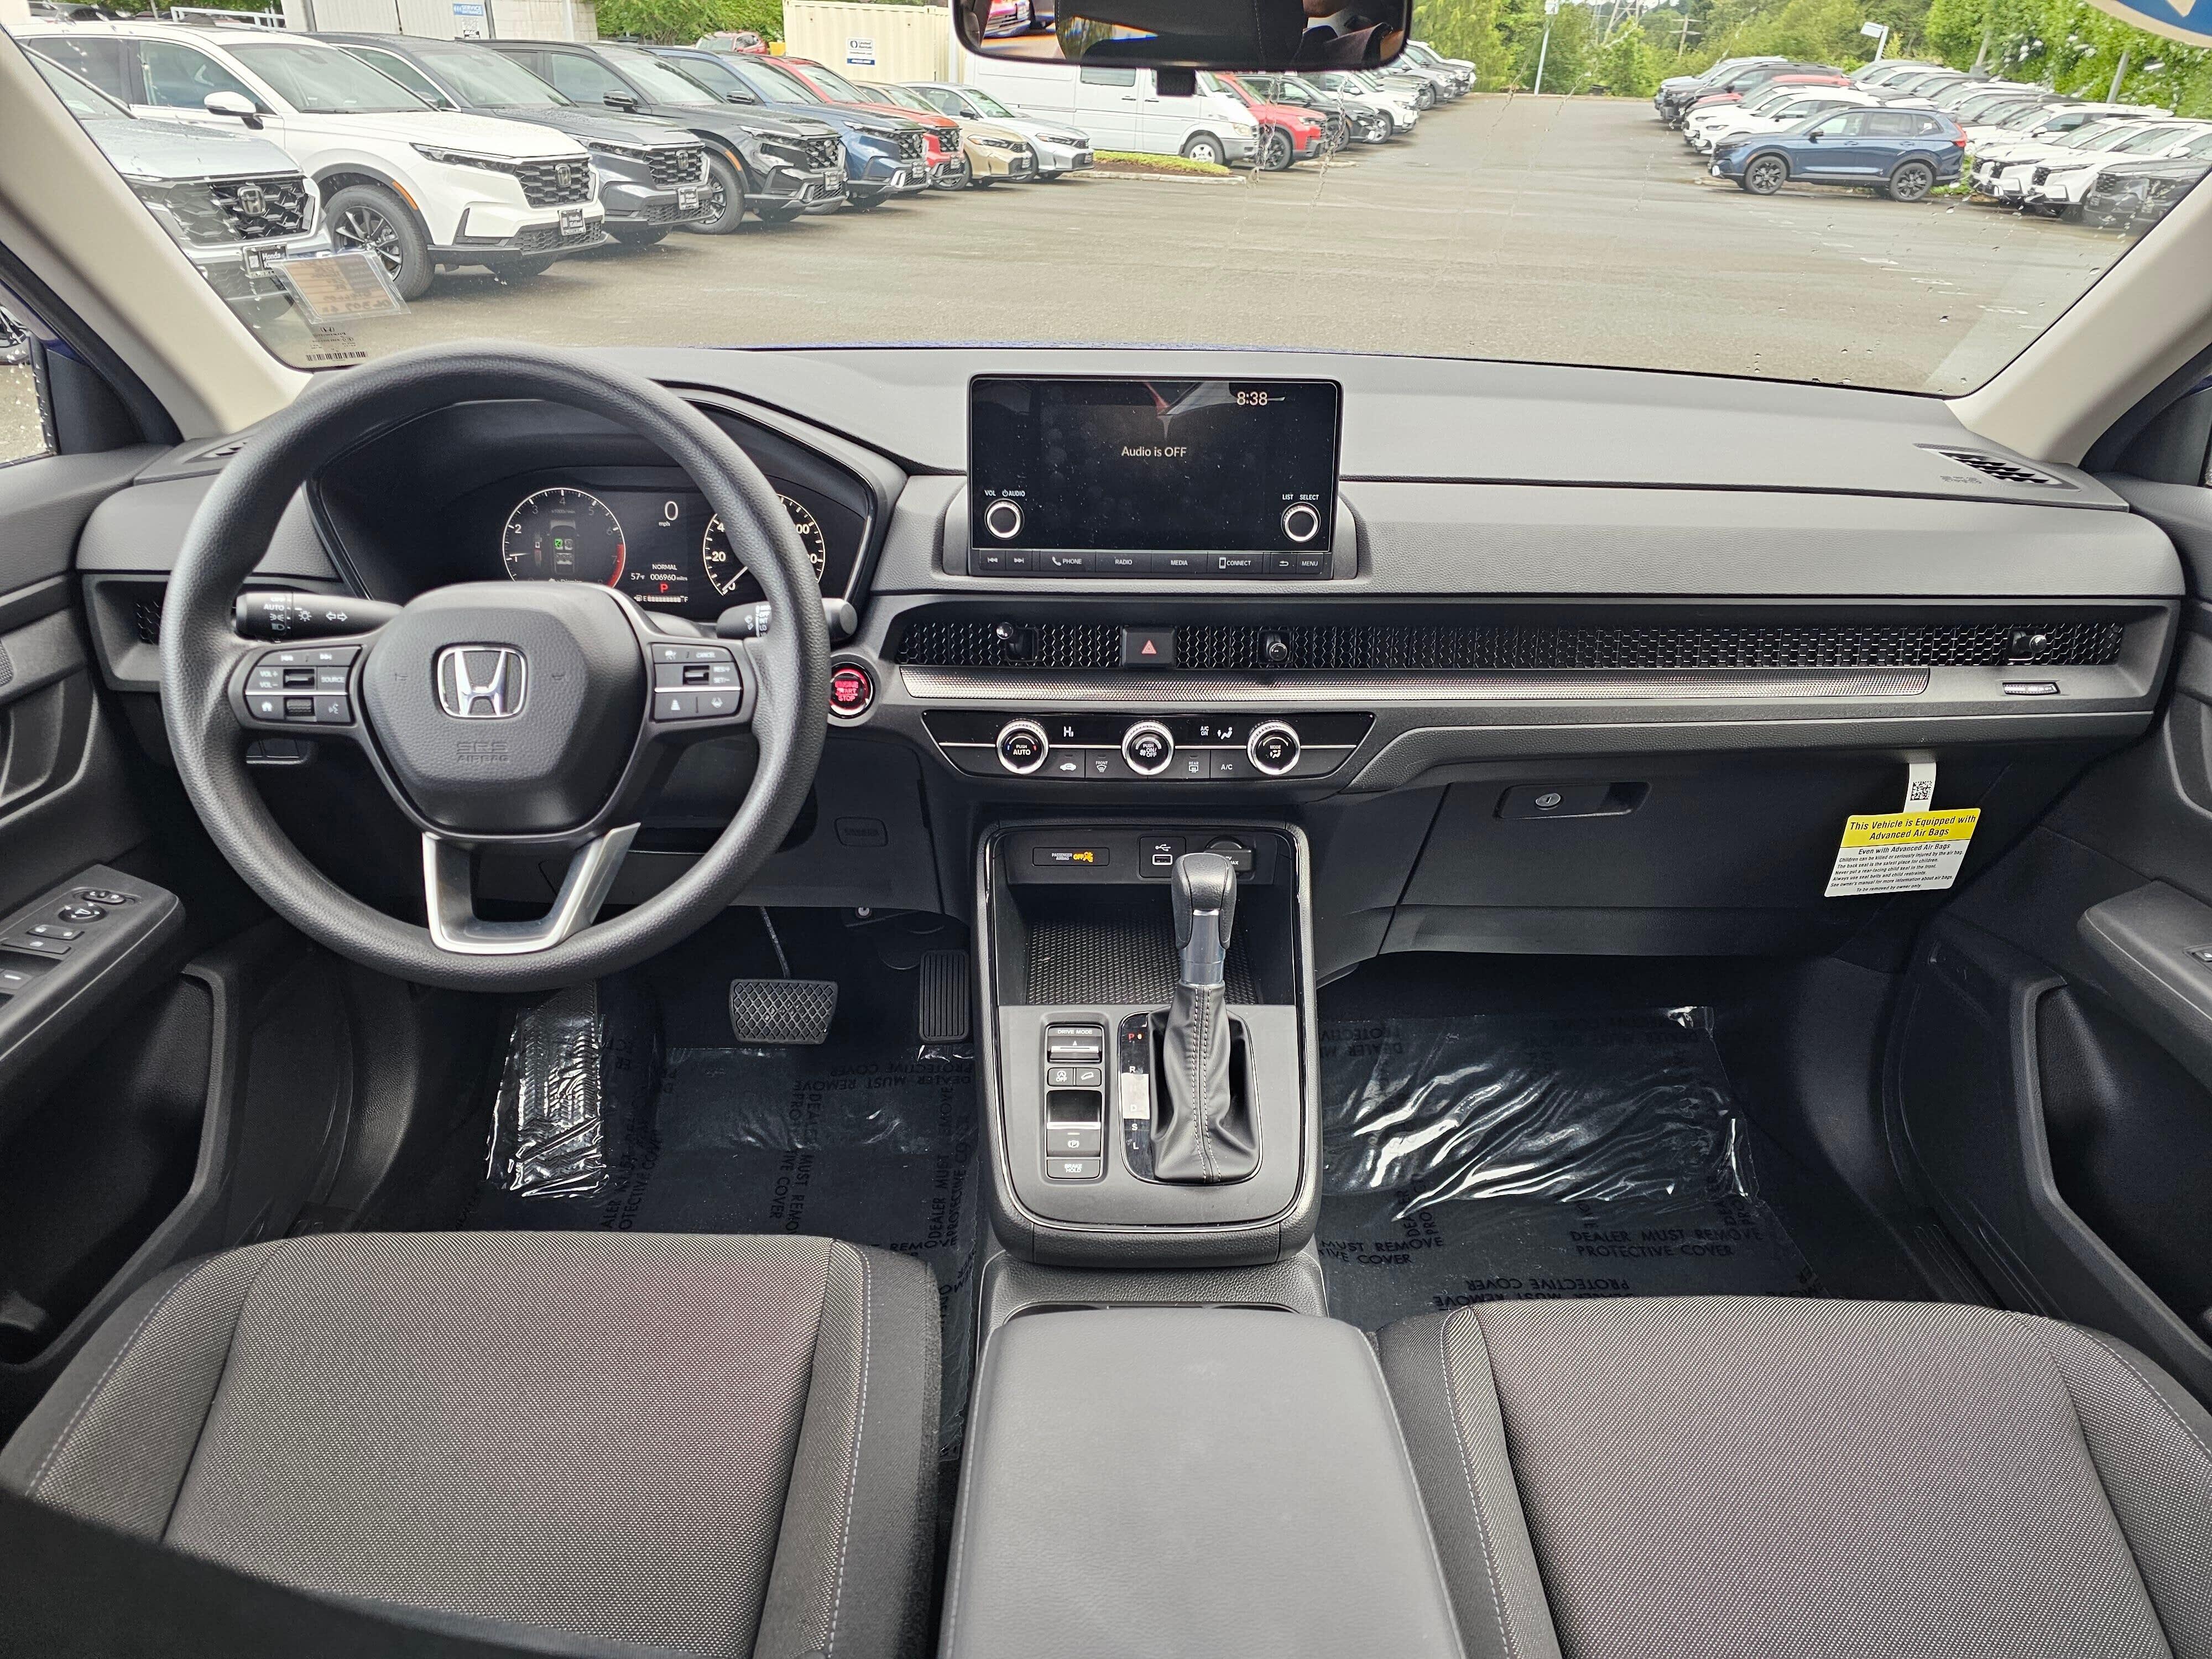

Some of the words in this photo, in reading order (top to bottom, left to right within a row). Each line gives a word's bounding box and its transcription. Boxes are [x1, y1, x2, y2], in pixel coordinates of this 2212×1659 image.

[1237, 392, 1267, 405] 8:38
[1121, 447, 1151, 457] Audio
[1154, 447, 1162, 457] is
[1164, 447, 1187, 457] OFF
[532, 505, 538, 514] 3
[588, 507, 594, 515] 5
[665, 501, 678, 520] 0
[515, 524, 521, 534] 2
[796, 524, 810, 534] 00
[612, 555, 617, 564] 7
[712, 551, 726, 561] 20
[660, 583, 668, 593] P
[1851, 822, 1869, 830] This
[1872, 820, 1903, 829] Vehicle
[1916, 816, 1955, 827] Equipped
[1869, 830, 1911, 840] Advanced
[1928, 828, 1949, 837] Bags
[1891, 844, 1923, 853] Advanced
[796, 1154, 815, 1187] MUST
[930, 1197, 946, 1239] DEALER
[1569, 1230, 1630, 1243] DEALER
[1641, 1229, 1686, 1243] MUST
[1374, 1237, 1444, 1251] REMOVE
[1576, 1244, 1678, 1258] PROTECTIVE
[1679, 1244, 1735, 1258] COVER
[1357, 1253, 1412, 1265] COVER
[1465, 1278, 1523, 1292] COVER
[1529, 1278, 1630, 1291] PROTECTIVE
